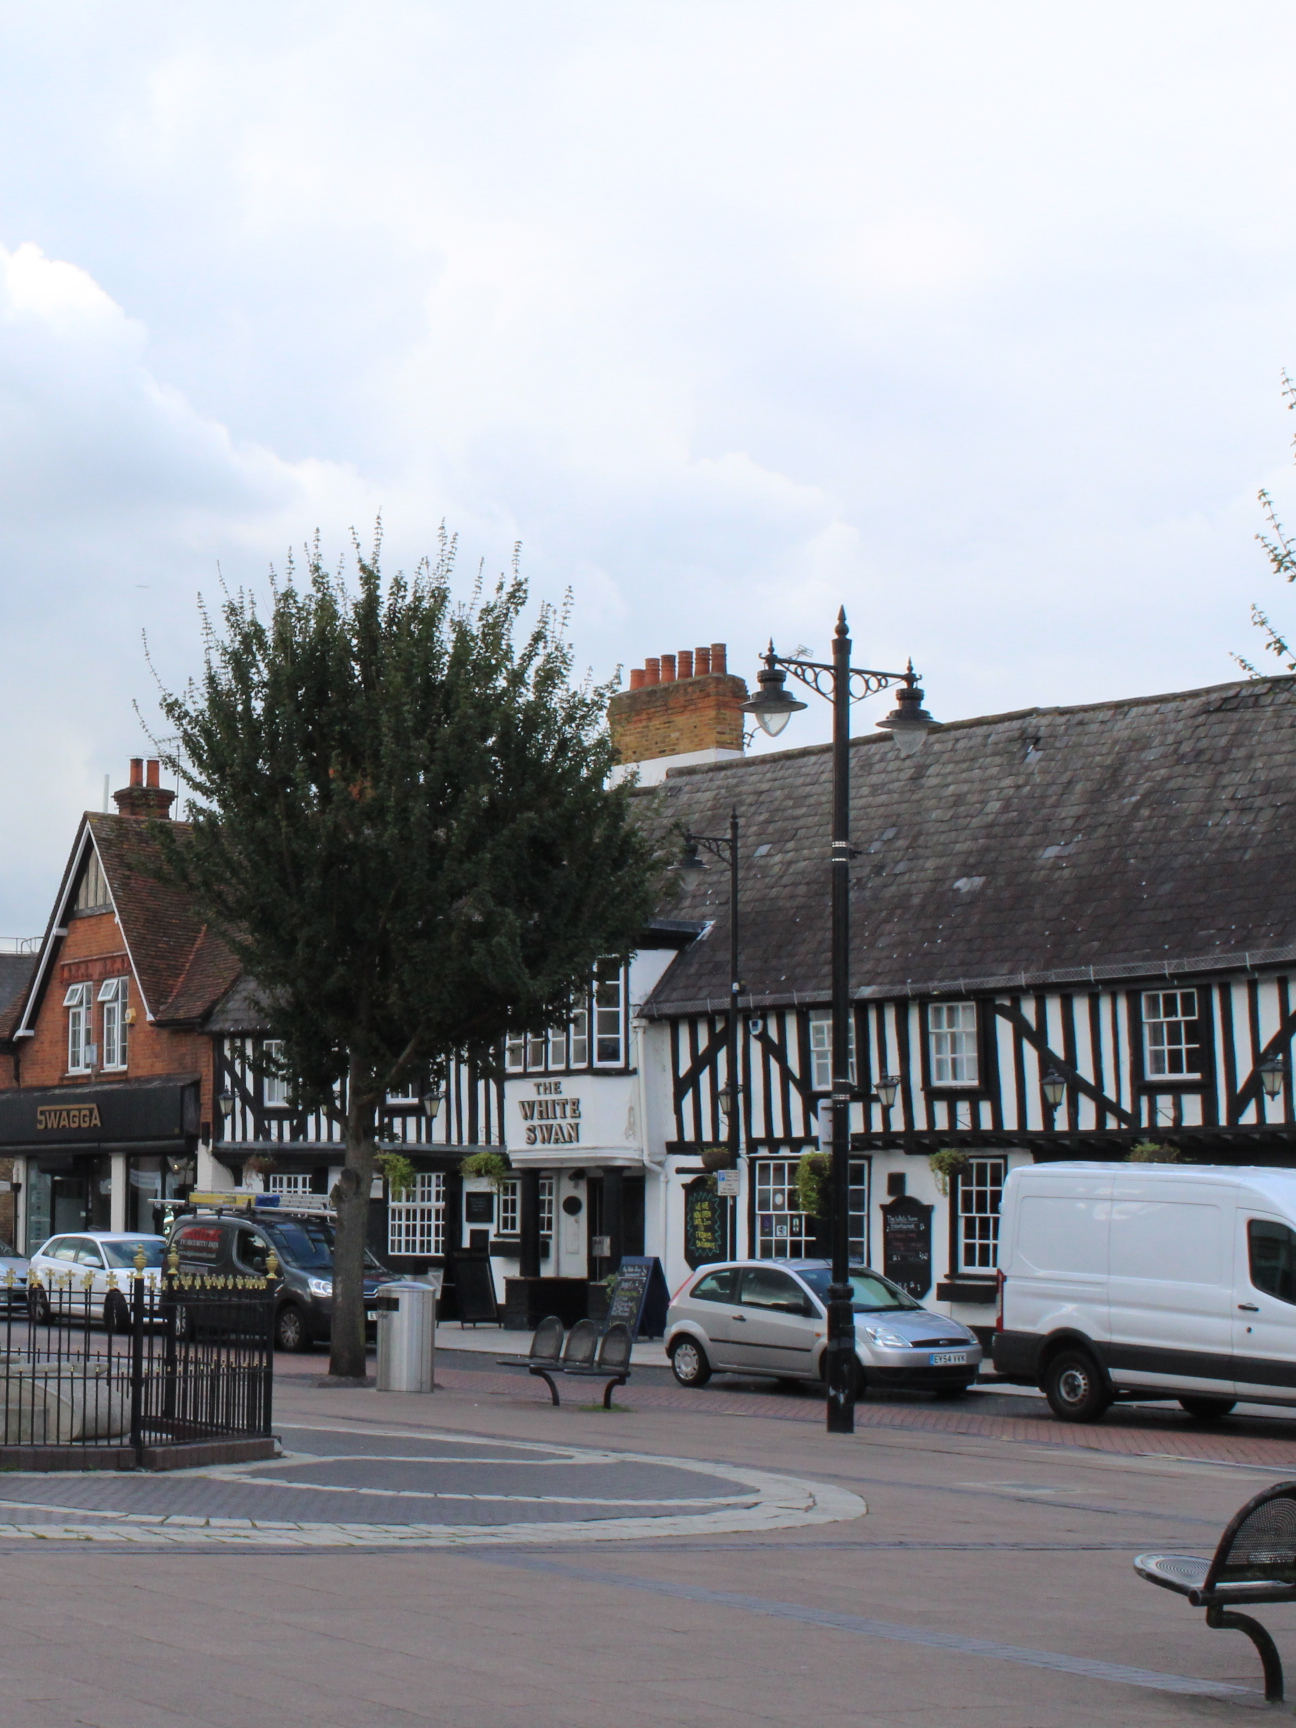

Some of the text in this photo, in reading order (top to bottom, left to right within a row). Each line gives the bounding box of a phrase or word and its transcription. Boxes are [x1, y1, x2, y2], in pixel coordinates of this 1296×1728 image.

[533, 1081, 562, 1095] THE
[37, 1103, 101, 1129] SWAGGA
[518, 1098, 581, 1120] WHITE
[525, 1122, 580, 1145] SWAN
